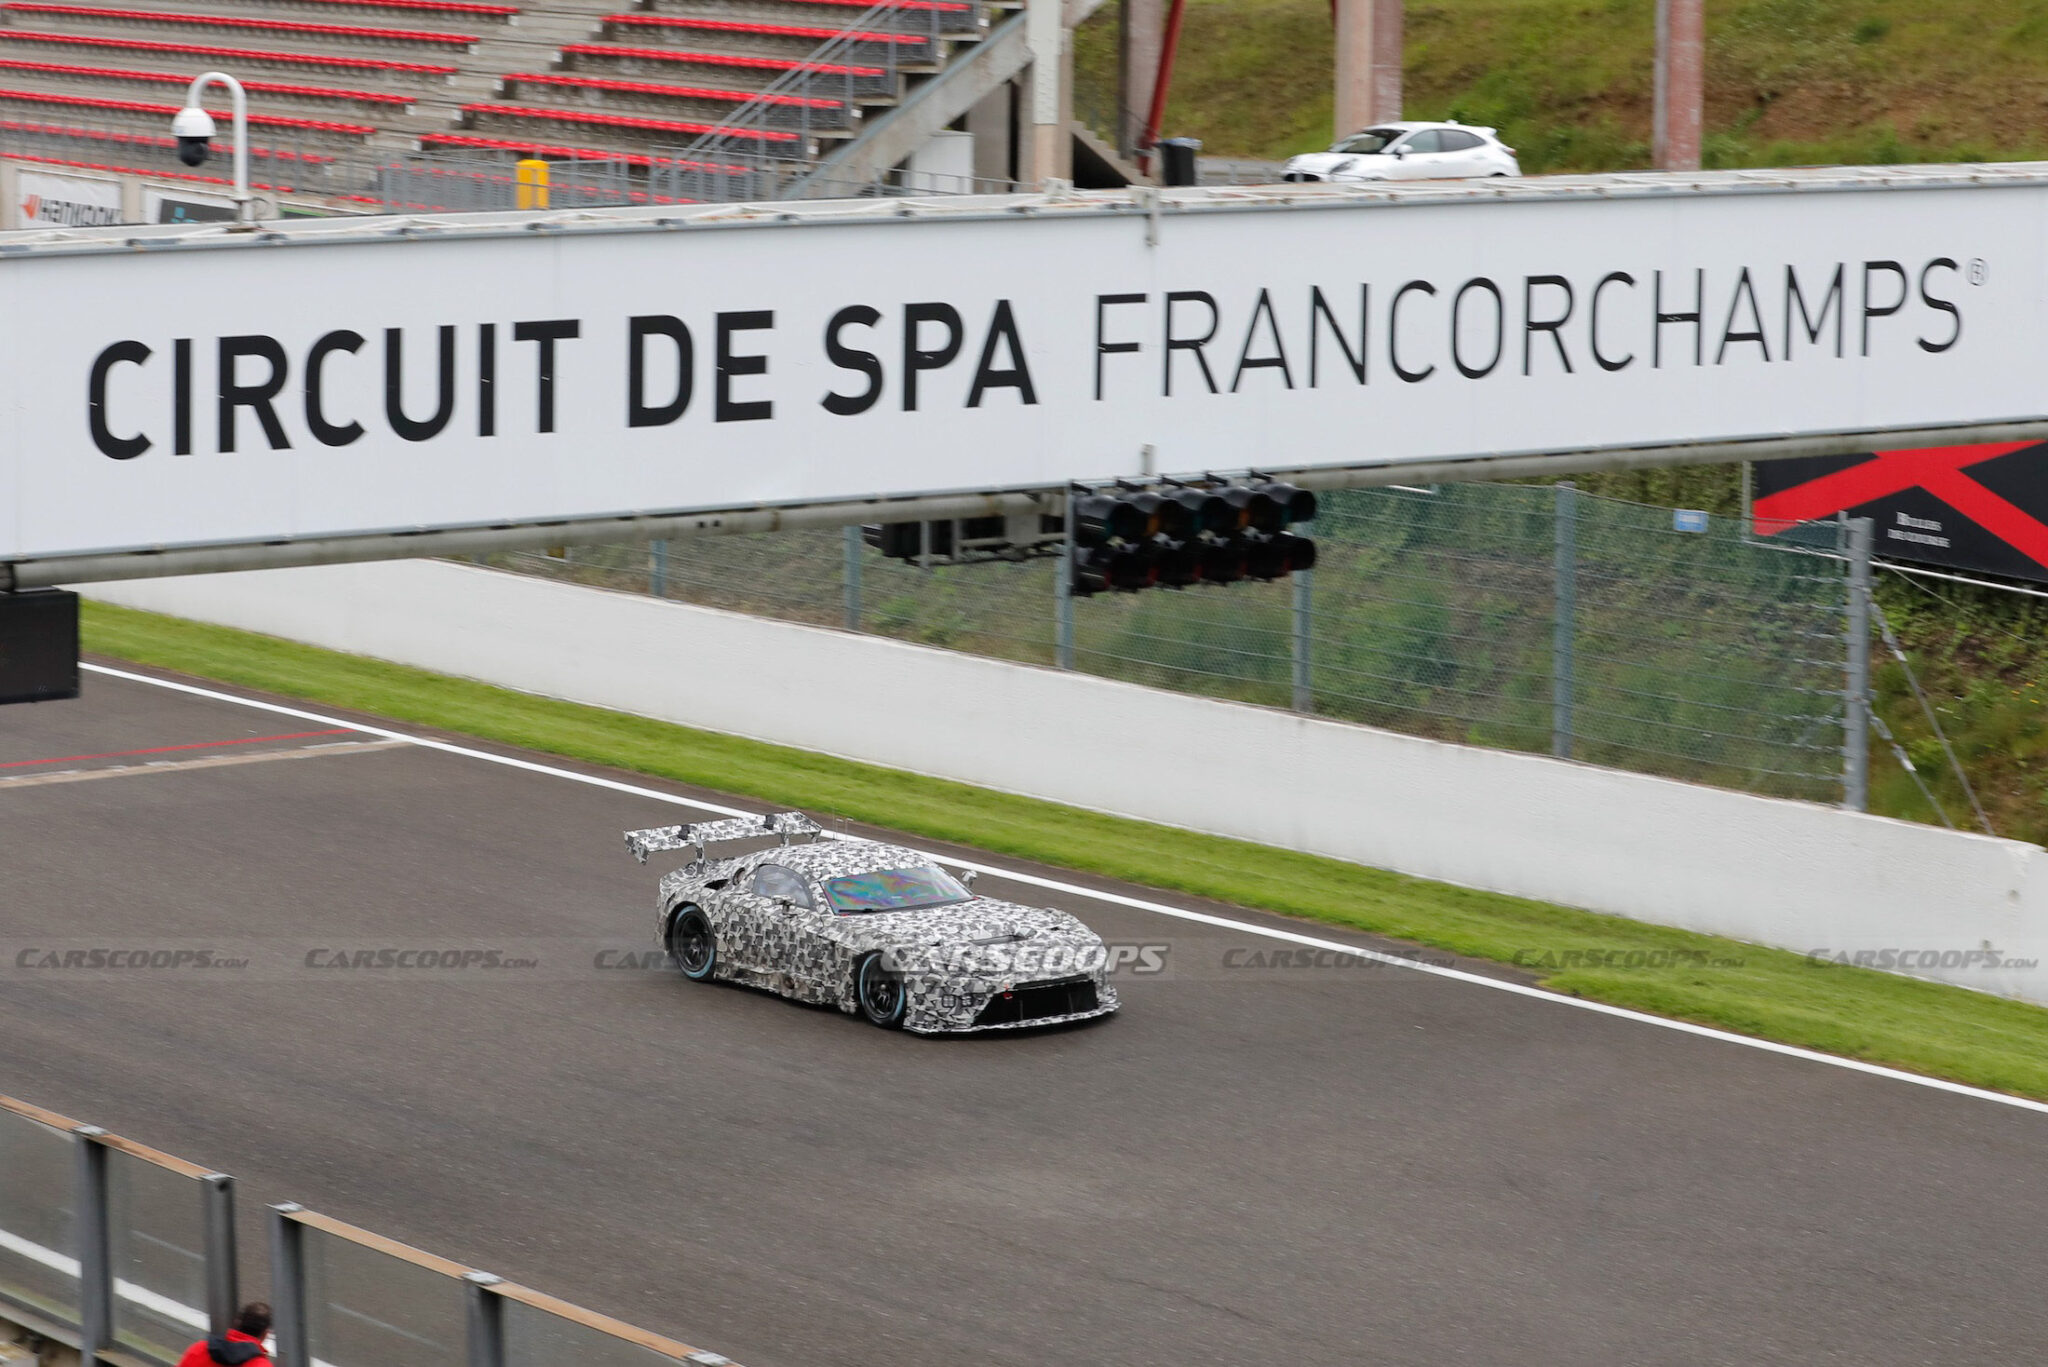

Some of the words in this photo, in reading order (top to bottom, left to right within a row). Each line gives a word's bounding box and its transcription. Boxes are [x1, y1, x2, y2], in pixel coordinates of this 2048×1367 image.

[89, 319, 579, 460] CIRCUIT
[628, 310, 774, 428] DE
[821, 300, 1038, 416] SPA
